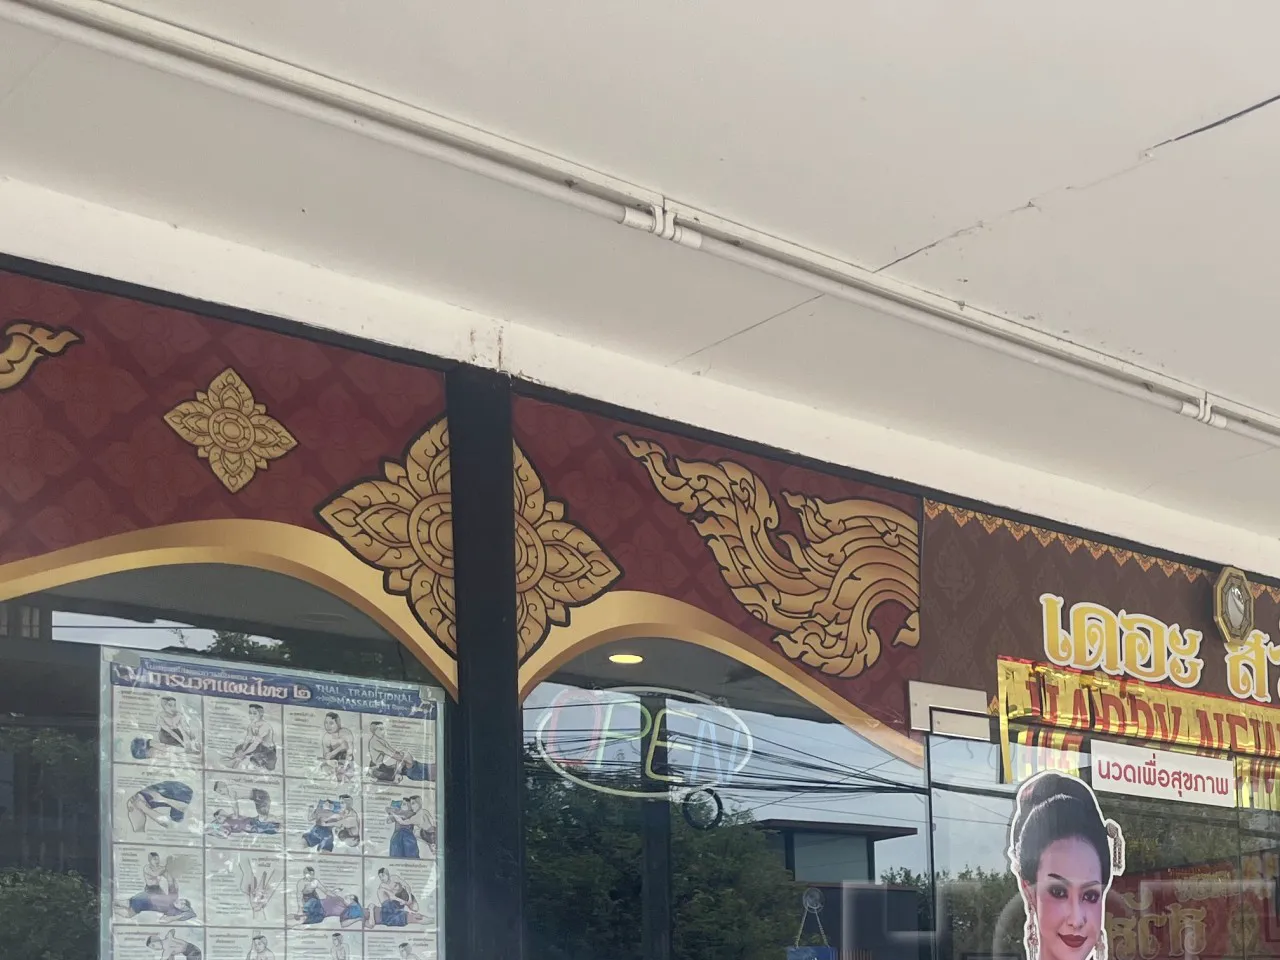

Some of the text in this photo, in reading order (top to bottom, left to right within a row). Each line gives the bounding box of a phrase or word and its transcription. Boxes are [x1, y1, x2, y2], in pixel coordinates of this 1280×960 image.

[1039, 593, 1203, 688] เดอะ
[316, 684, 339, 695] THAI
[548, 687, 742, 784] OPEN
[1097, 753, 1230, 798] นวดเพื่อสุขภาพ
